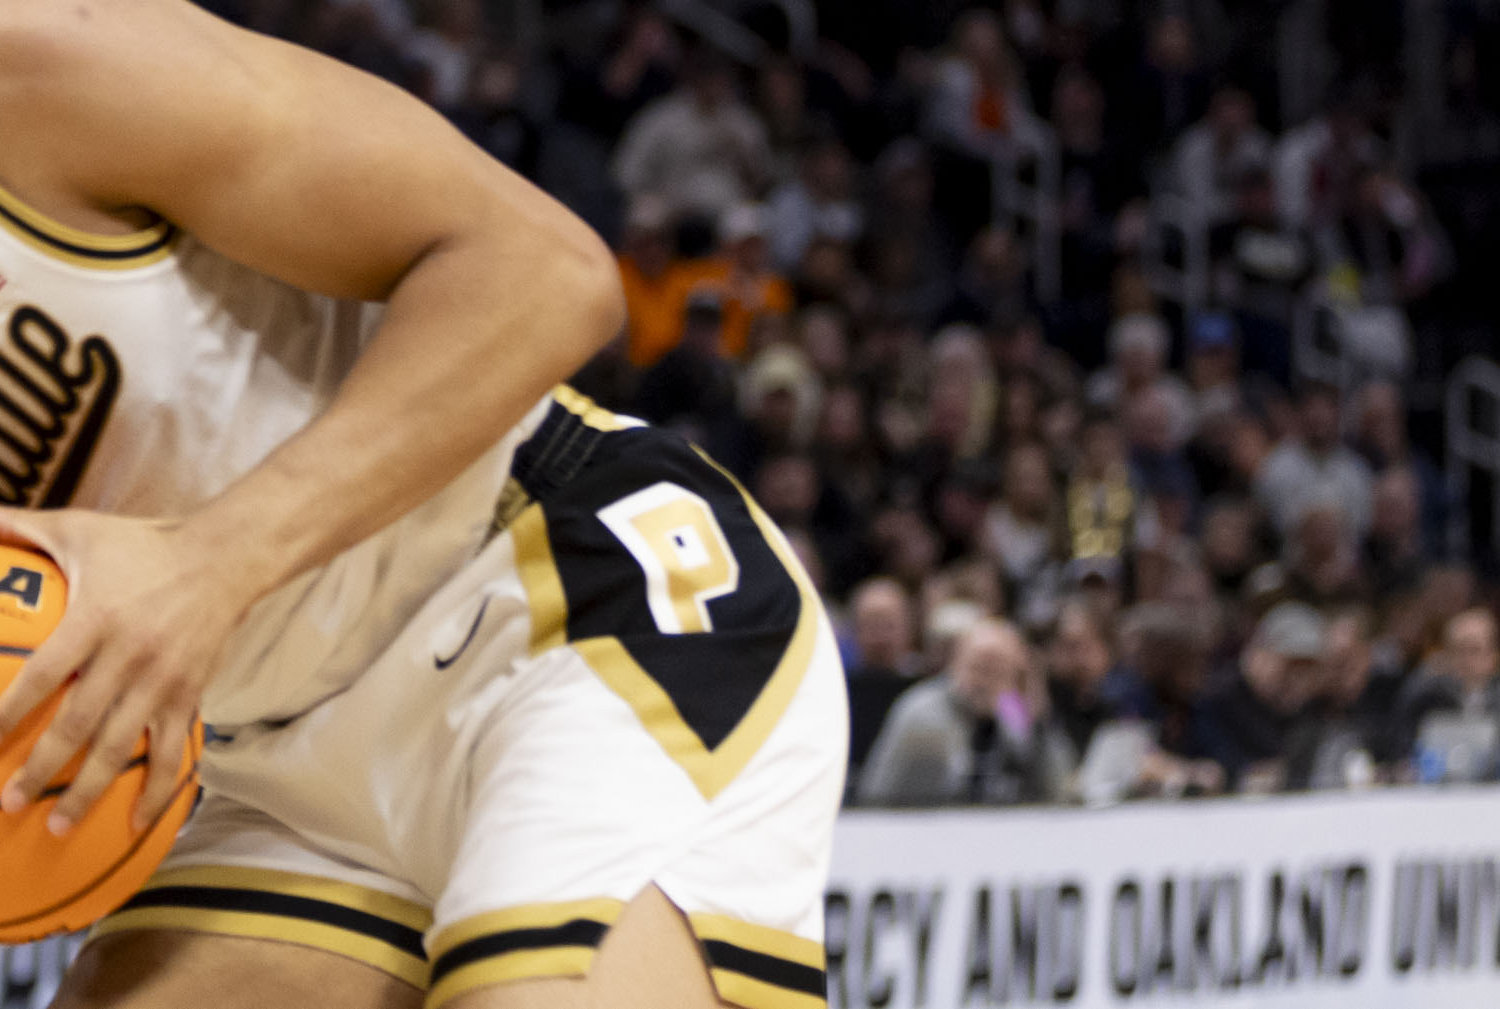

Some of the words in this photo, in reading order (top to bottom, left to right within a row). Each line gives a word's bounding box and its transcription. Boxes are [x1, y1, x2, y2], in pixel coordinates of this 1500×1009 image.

[596, 481, 740, 635] P
[961, 879, 1082, 1004] AND
[1110, 862, 1369, 996] OAKLAND
